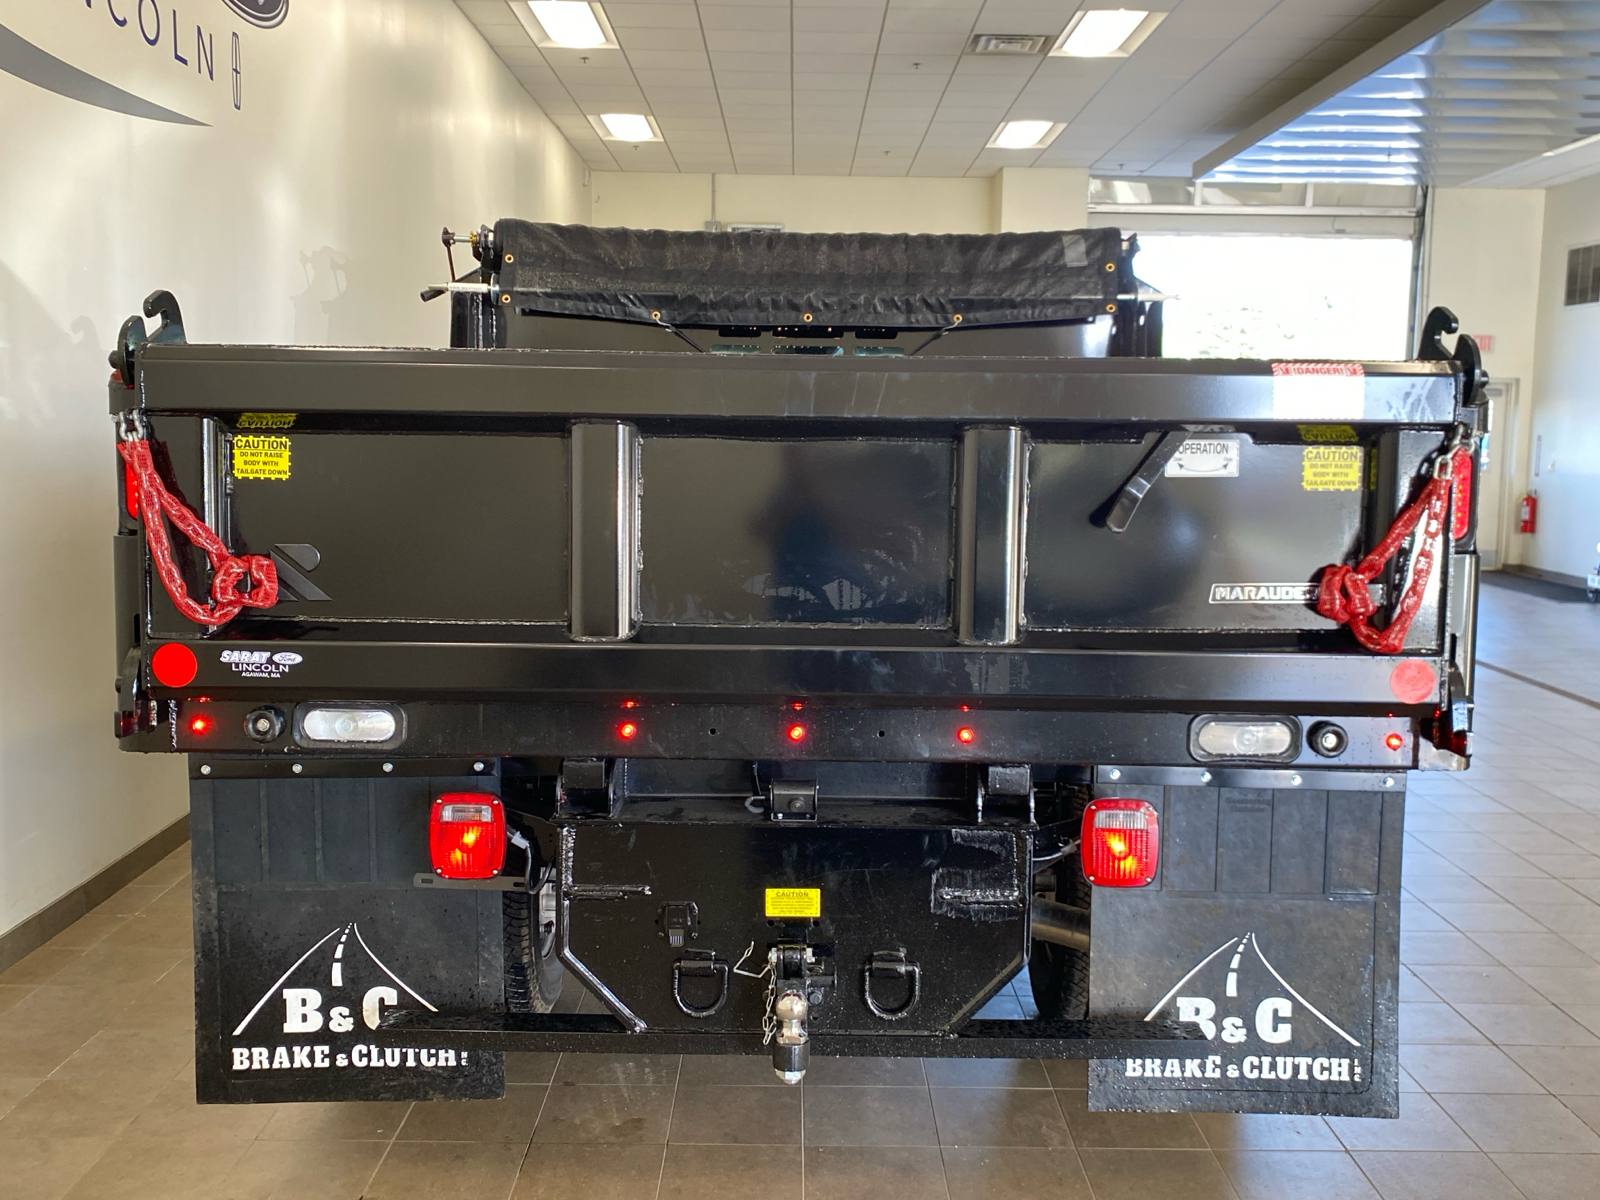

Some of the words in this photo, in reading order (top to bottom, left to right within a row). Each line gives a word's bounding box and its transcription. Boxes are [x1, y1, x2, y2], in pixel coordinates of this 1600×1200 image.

[235, 438, 287, 450] CAUTION
[1178, 442, 1229, 455] OPERATION
[1305, 450, 1358, 461] CAUTION
[219, 649, 271, 664] SARAT
[231, 663, 289, 673] LINCOLN
[282, 988, 324, 1034] B
[328, 1006, 355, 1033] &
[1176, 996, 1216, 1041] B
[1221, 1016, 1247, 1044] &
[1255, 996, 1292, 1044] C
[231, 1045, 330, 1070] BRAKE
[335, 1053, 349, 1067] &
[351, 1044, 457, 1068] CLUTCH
[1125, 1055, 1221, 1079] BRAKE
[1226, 1064, 1240, 1078] &
[1242, 1055, 1351, 1082] CLUTCH
